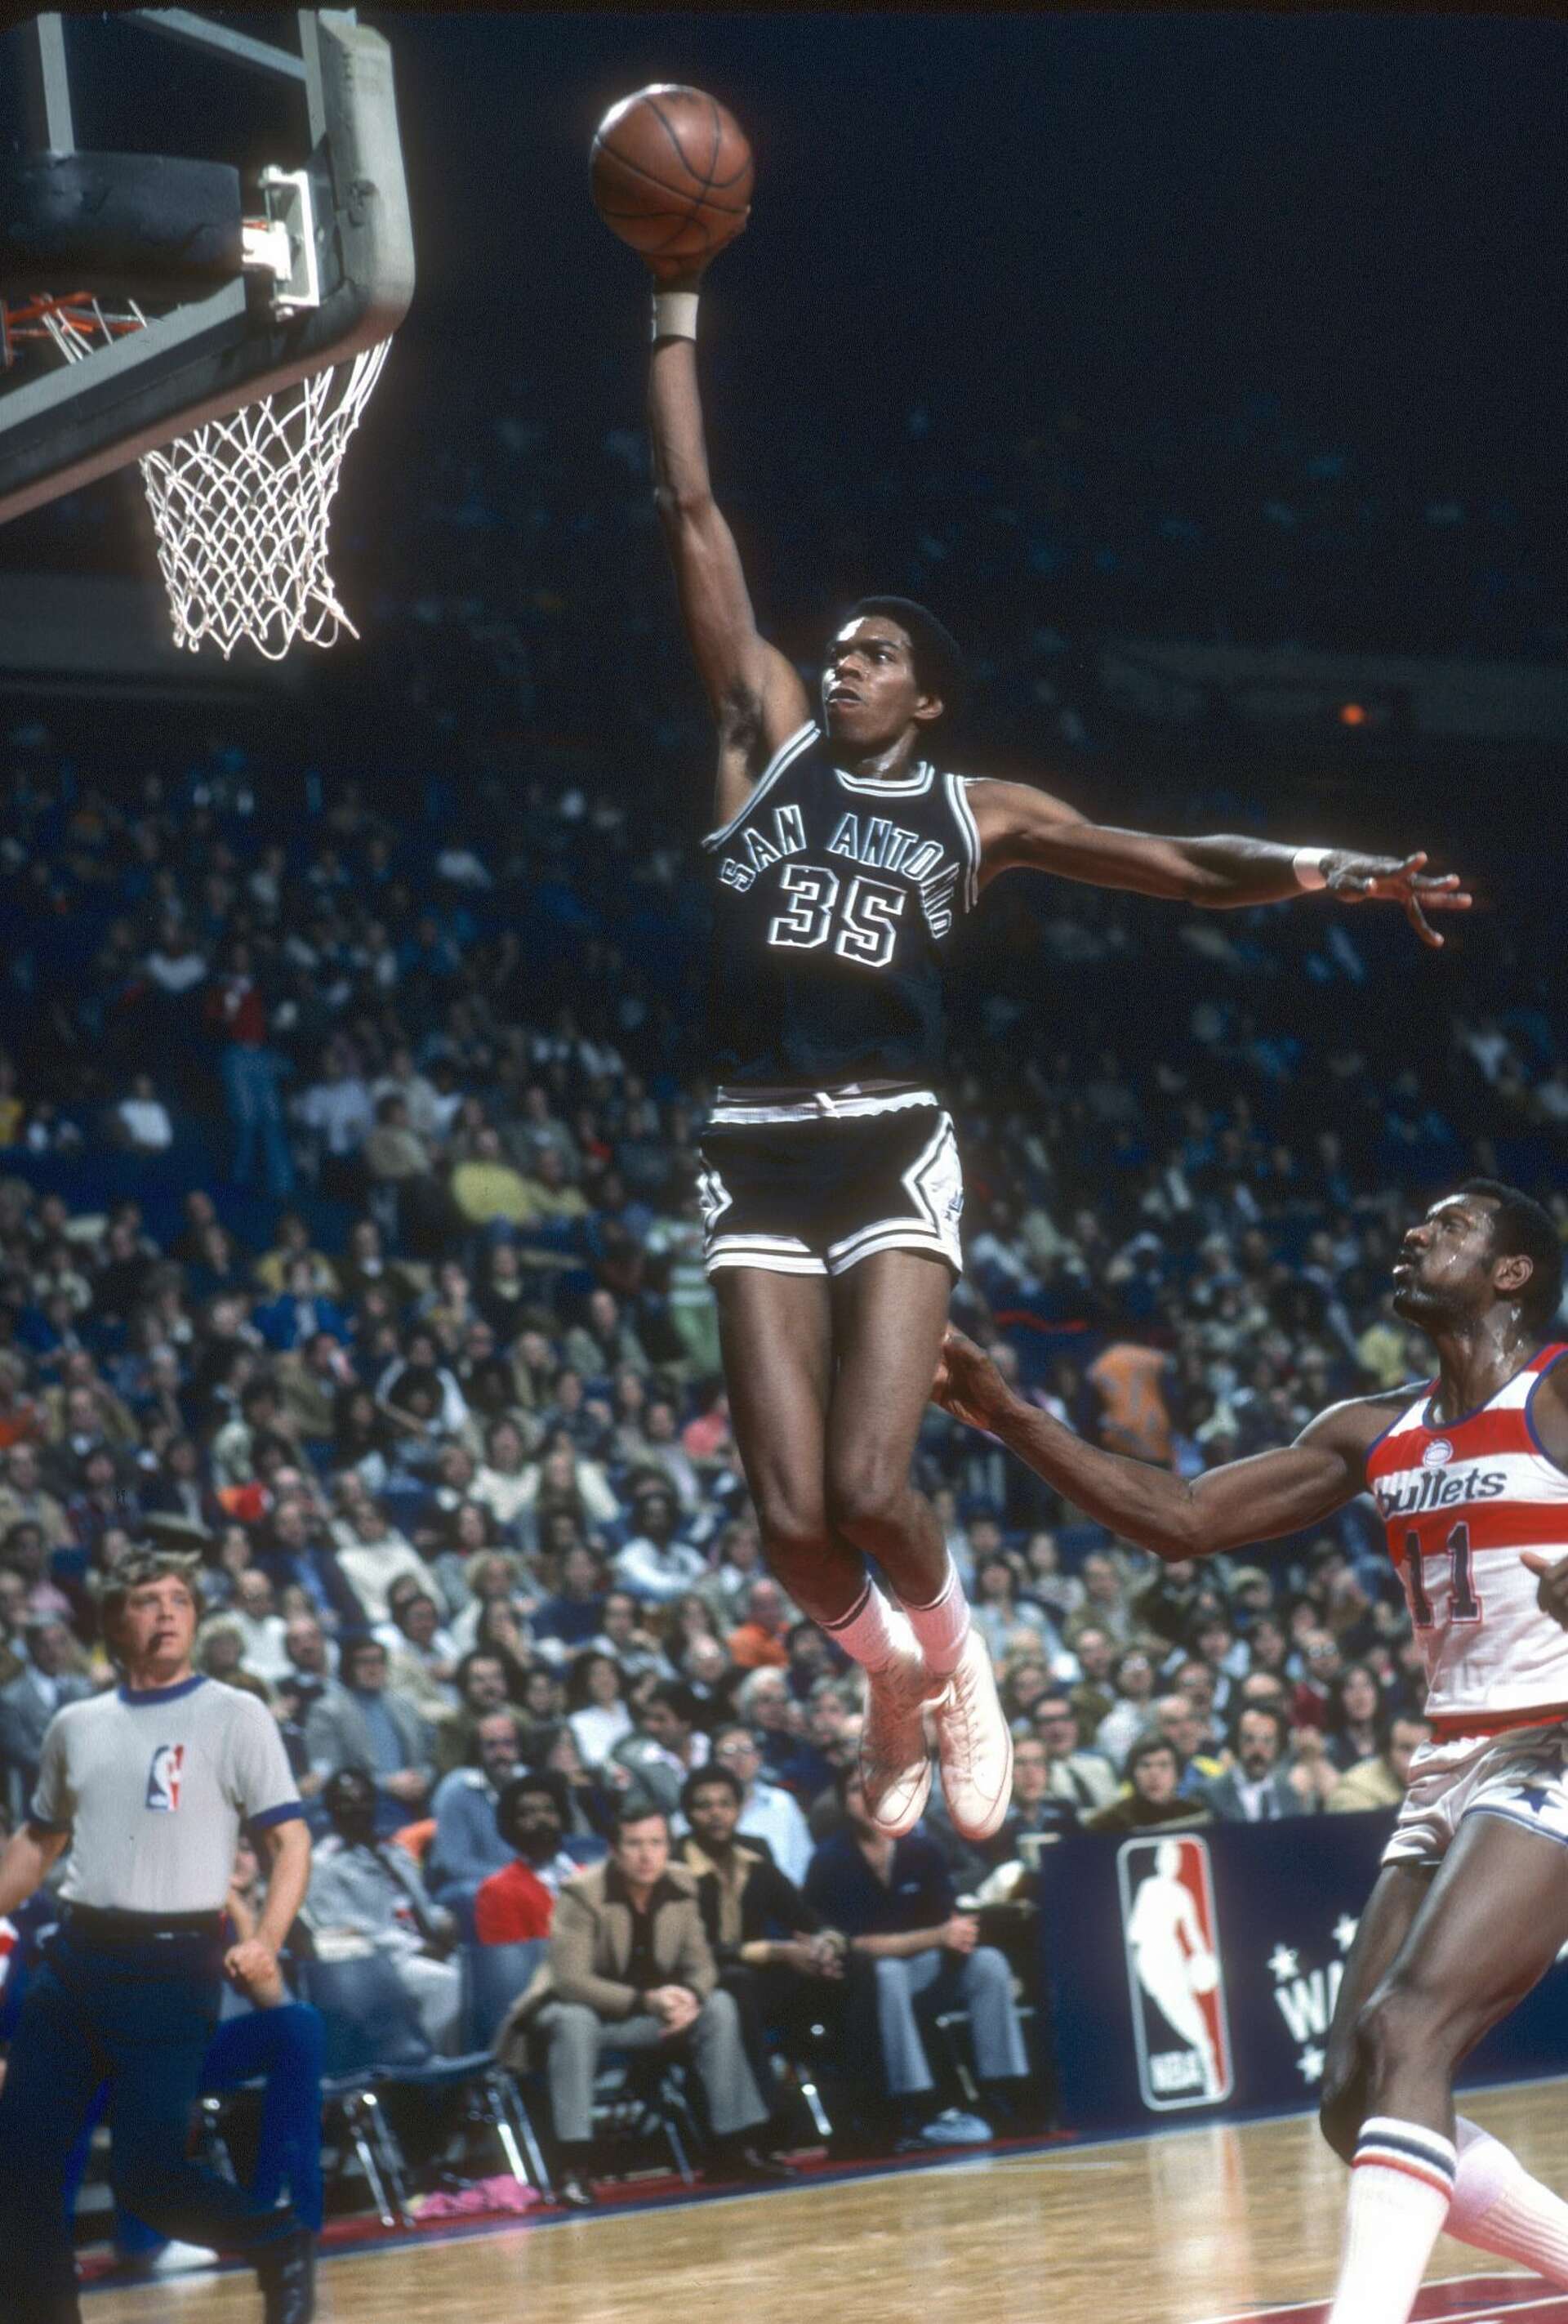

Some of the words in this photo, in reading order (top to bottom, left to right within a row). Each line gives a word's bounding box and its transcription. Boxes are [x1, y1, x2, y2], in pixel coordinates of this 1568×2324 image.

[719, 805, 808, 892] SAN
[768, 864, 907, 967] 35
[1405, 1521, 1482, 1628] 11
